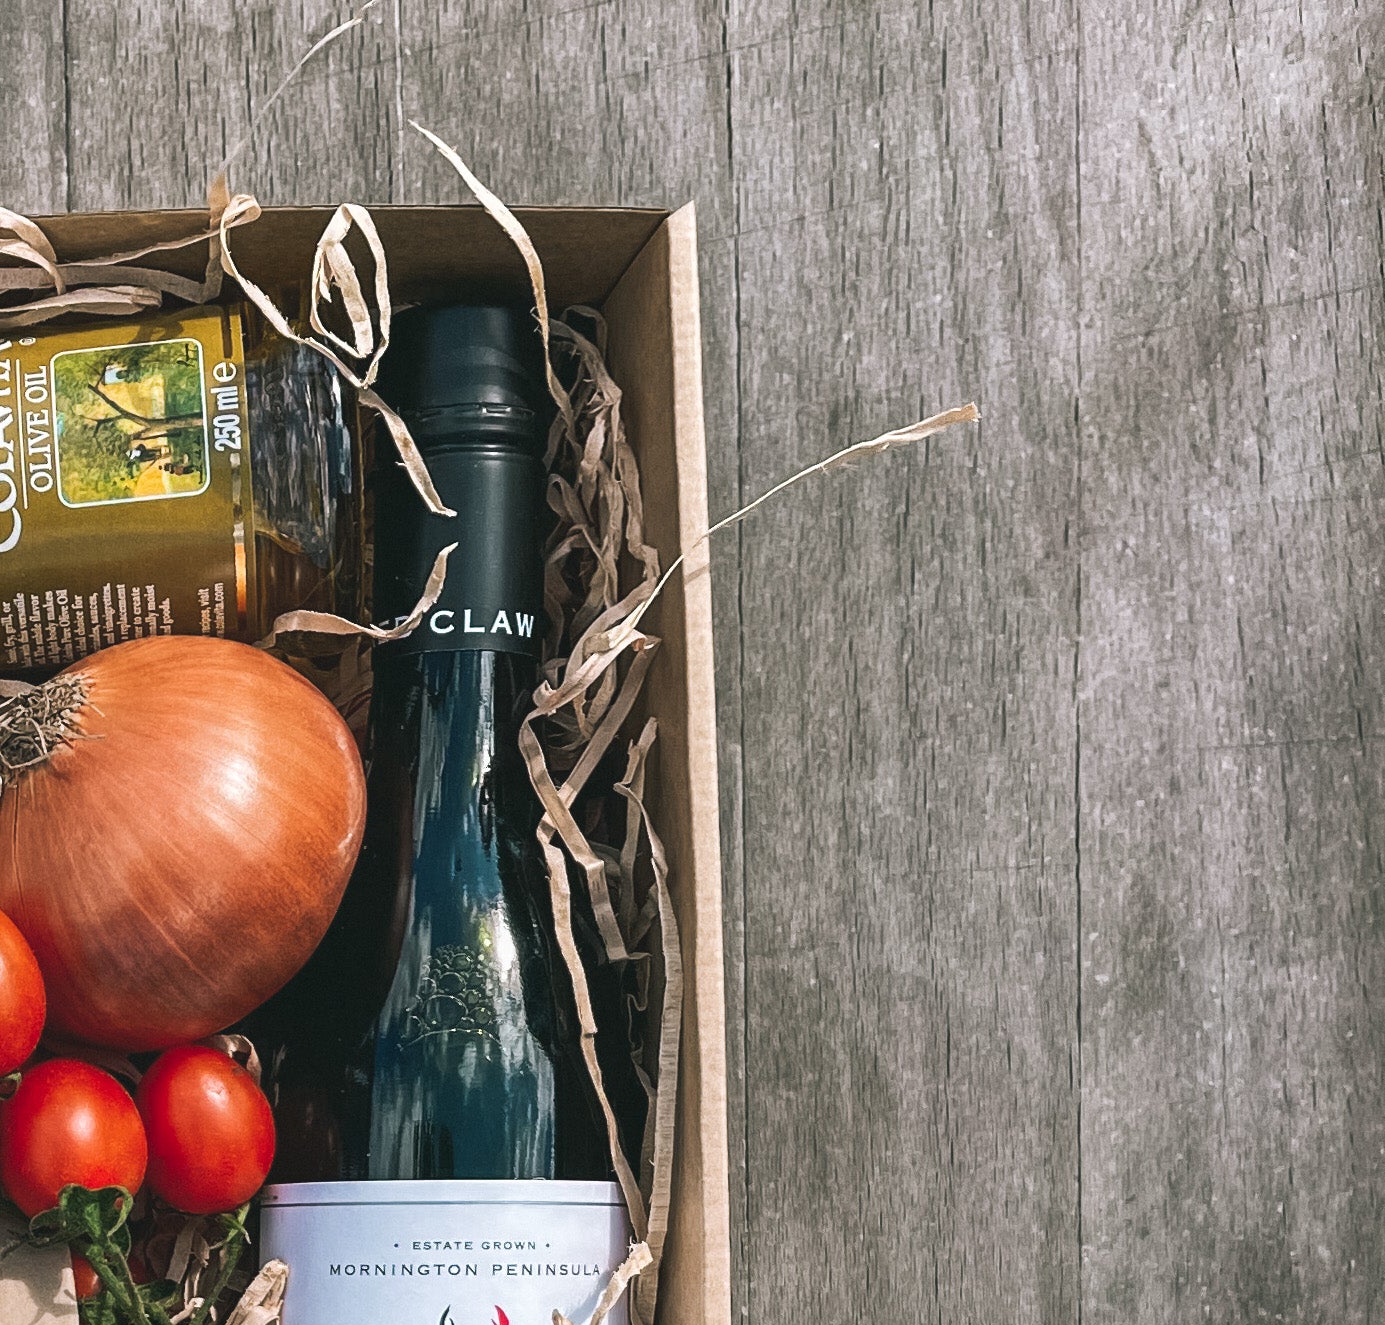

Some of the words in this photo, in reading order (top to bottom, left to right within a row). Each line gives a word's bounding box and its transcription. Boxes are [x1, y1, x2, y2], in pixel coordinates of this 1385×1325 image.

[25, 366, 52, 402] OIL
[211, 386, 238, 410] ml
[213, 414, 241, 452] 250
[26, 409, 54, 493] OLIVE
[2, 601, 11, 613] or
[29, 594, 41, 622] flavor
[42, 591, 55, 620] makes
[56, 589, 68, 604] Oil
[71, 594, 83, 609] for
[130, 586, 141, 615] create
[144, 584, 156, 610] moist
[58, 605, 70, 627] Olive
[133, 616, 142, 625] to
[430, 609, 534, 637] CLAW
[413, 1241, 473, 1250] ESTATE
[481, 1241, 536, 1250] GROWN
[330, 1264, 478, 1276] MORNINGTON
[492, 1264, 601, 1275] PENINSULA
